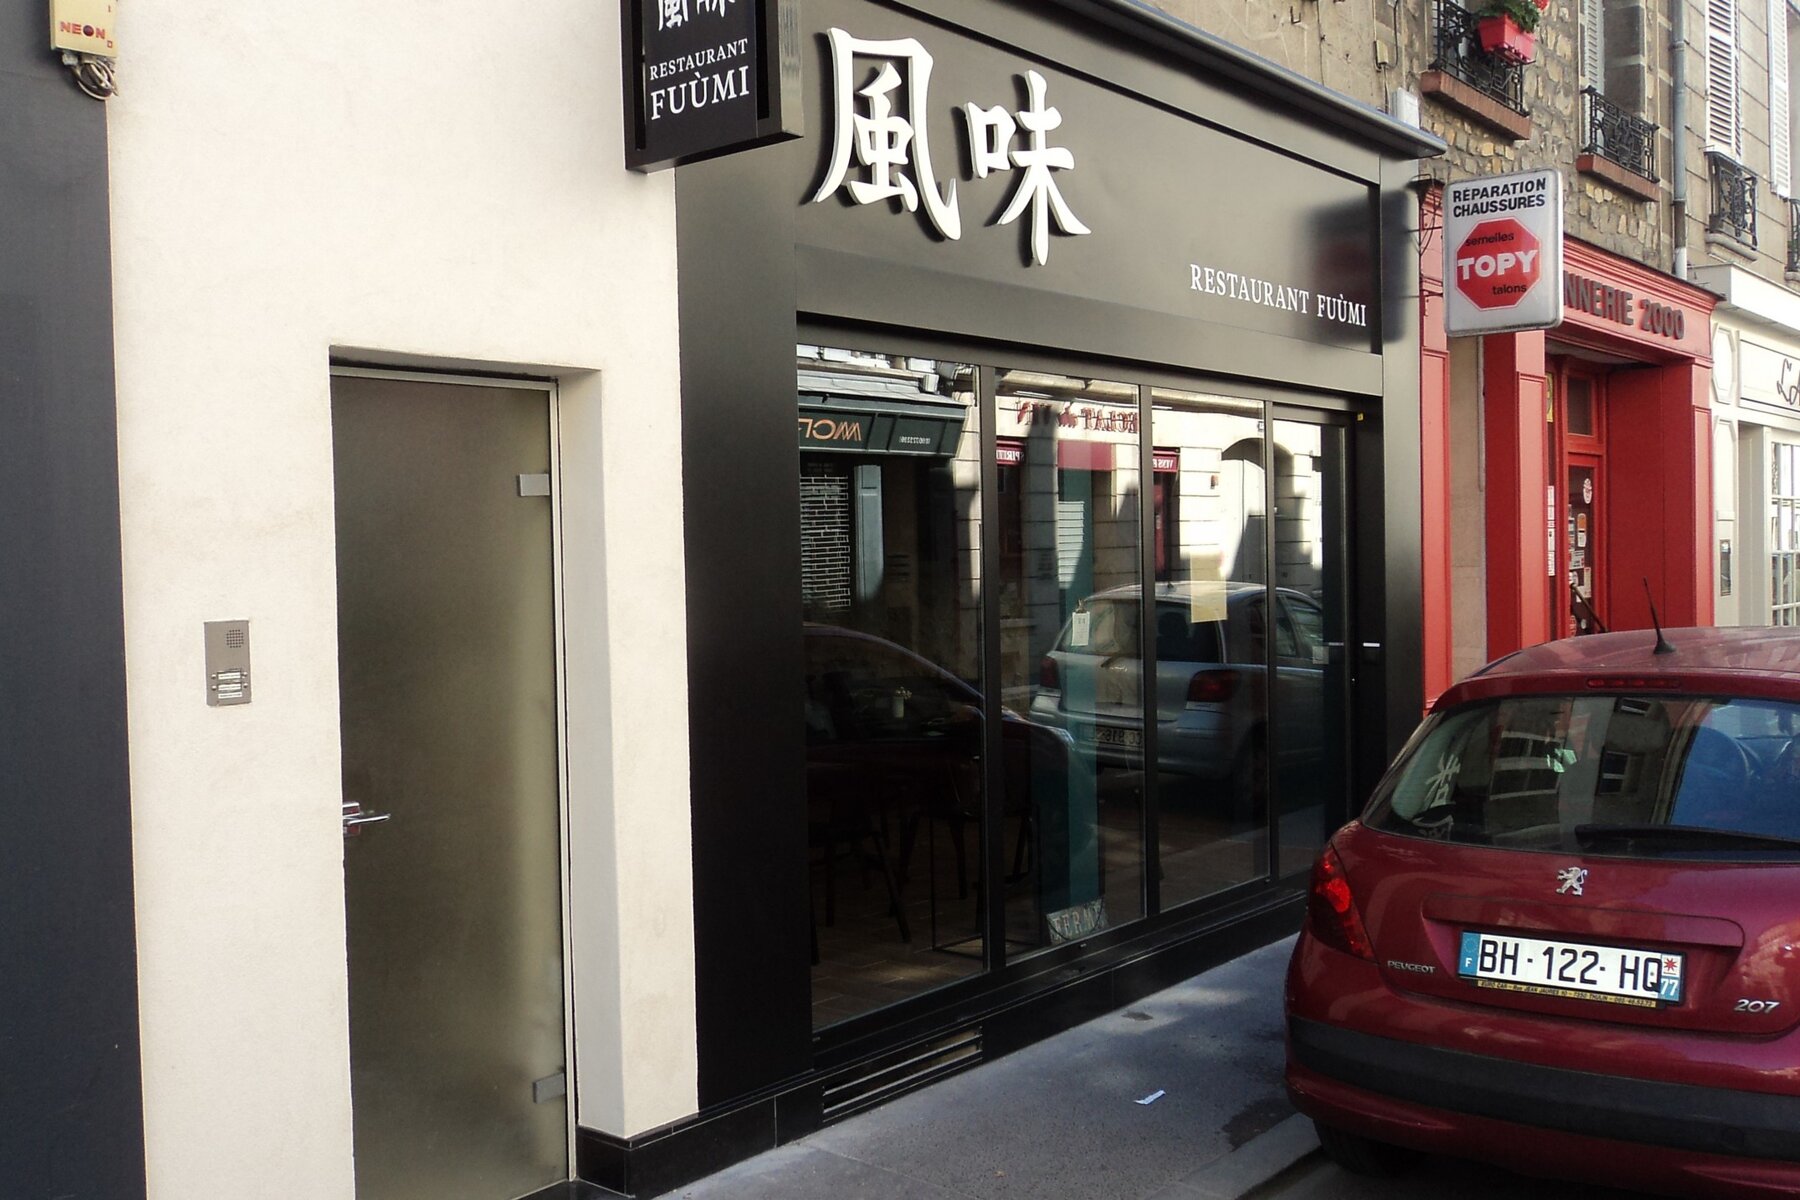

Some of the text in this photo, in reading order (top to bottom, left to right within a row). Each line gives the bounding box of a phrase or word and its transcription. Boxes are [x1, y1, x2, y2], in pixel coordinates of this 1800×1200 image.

[60, 21, 105, 39] NEON
[650, 38, 748, 80] RESTAURANT
[651, 66, 749, 120] FUÙMI
[812, 27, 1092, 266] 風味
[1453, 178, 1546, 202] RÉPARATION
[1453, 194, 1545, 218] CHAUSSURES
[1465, 232, 1514, 246] semelles
[1457, 250, 1538, 280] TOPY
[1190, 264, 1367, 327] RESTAURANT FUÙMI
[1492, 284, 1527, 295] talons
[1563, 270, 1685, 340] NNERIE 2000
[1387, 960, 1436, 973] PEUGEOT
[1465, 957, 1472, 968] F
[1661, 979, 1678, 996] 77
[1733, 998, 1780, 1014] 207
